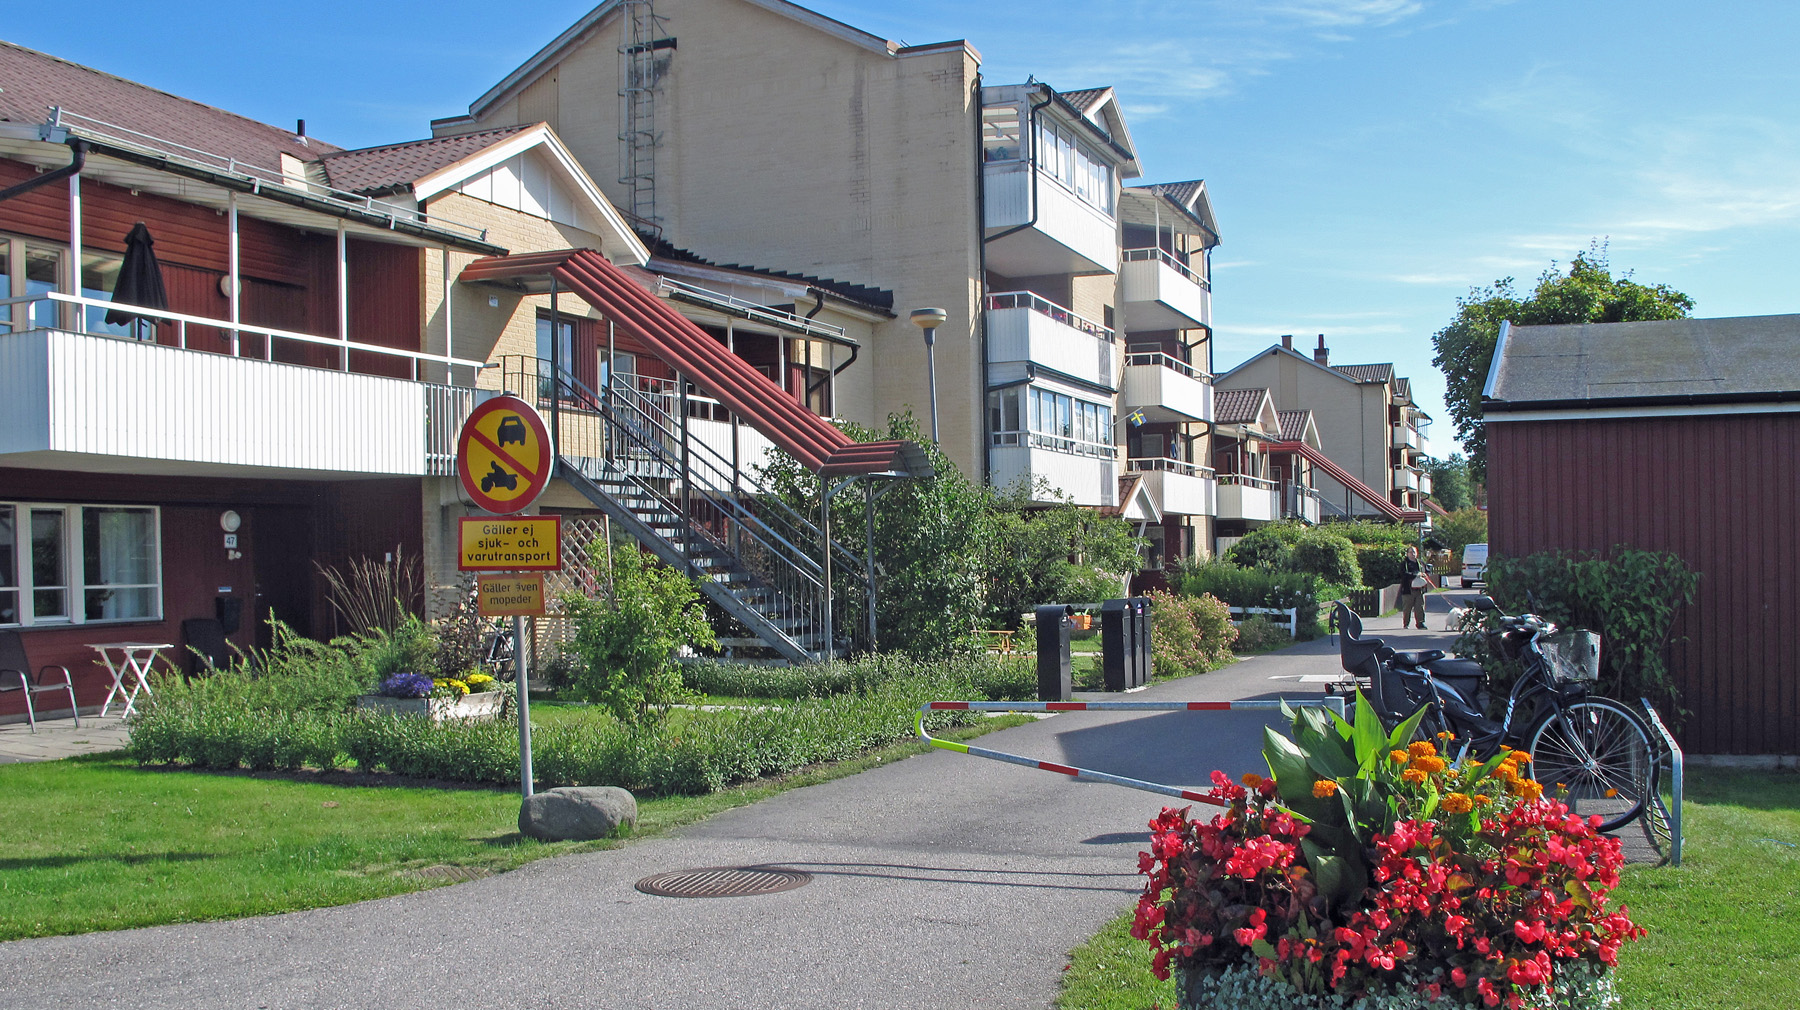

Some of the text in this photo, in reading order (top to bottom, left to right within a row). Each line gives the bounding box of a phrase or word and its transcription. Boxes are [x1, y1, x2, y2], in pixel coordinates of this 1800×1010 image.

[483, 524, 534, 536] Gäller ej
[226, 536, 235, 545] 47
[478, 538, 539, 550] sjuk- och
[467, 551, 551, 563] varutransport
[482, 583, 511, 593] Gäller
[490, 595, 532, 606] mopeder
[1503, 696, 1515, 732] PEAK
